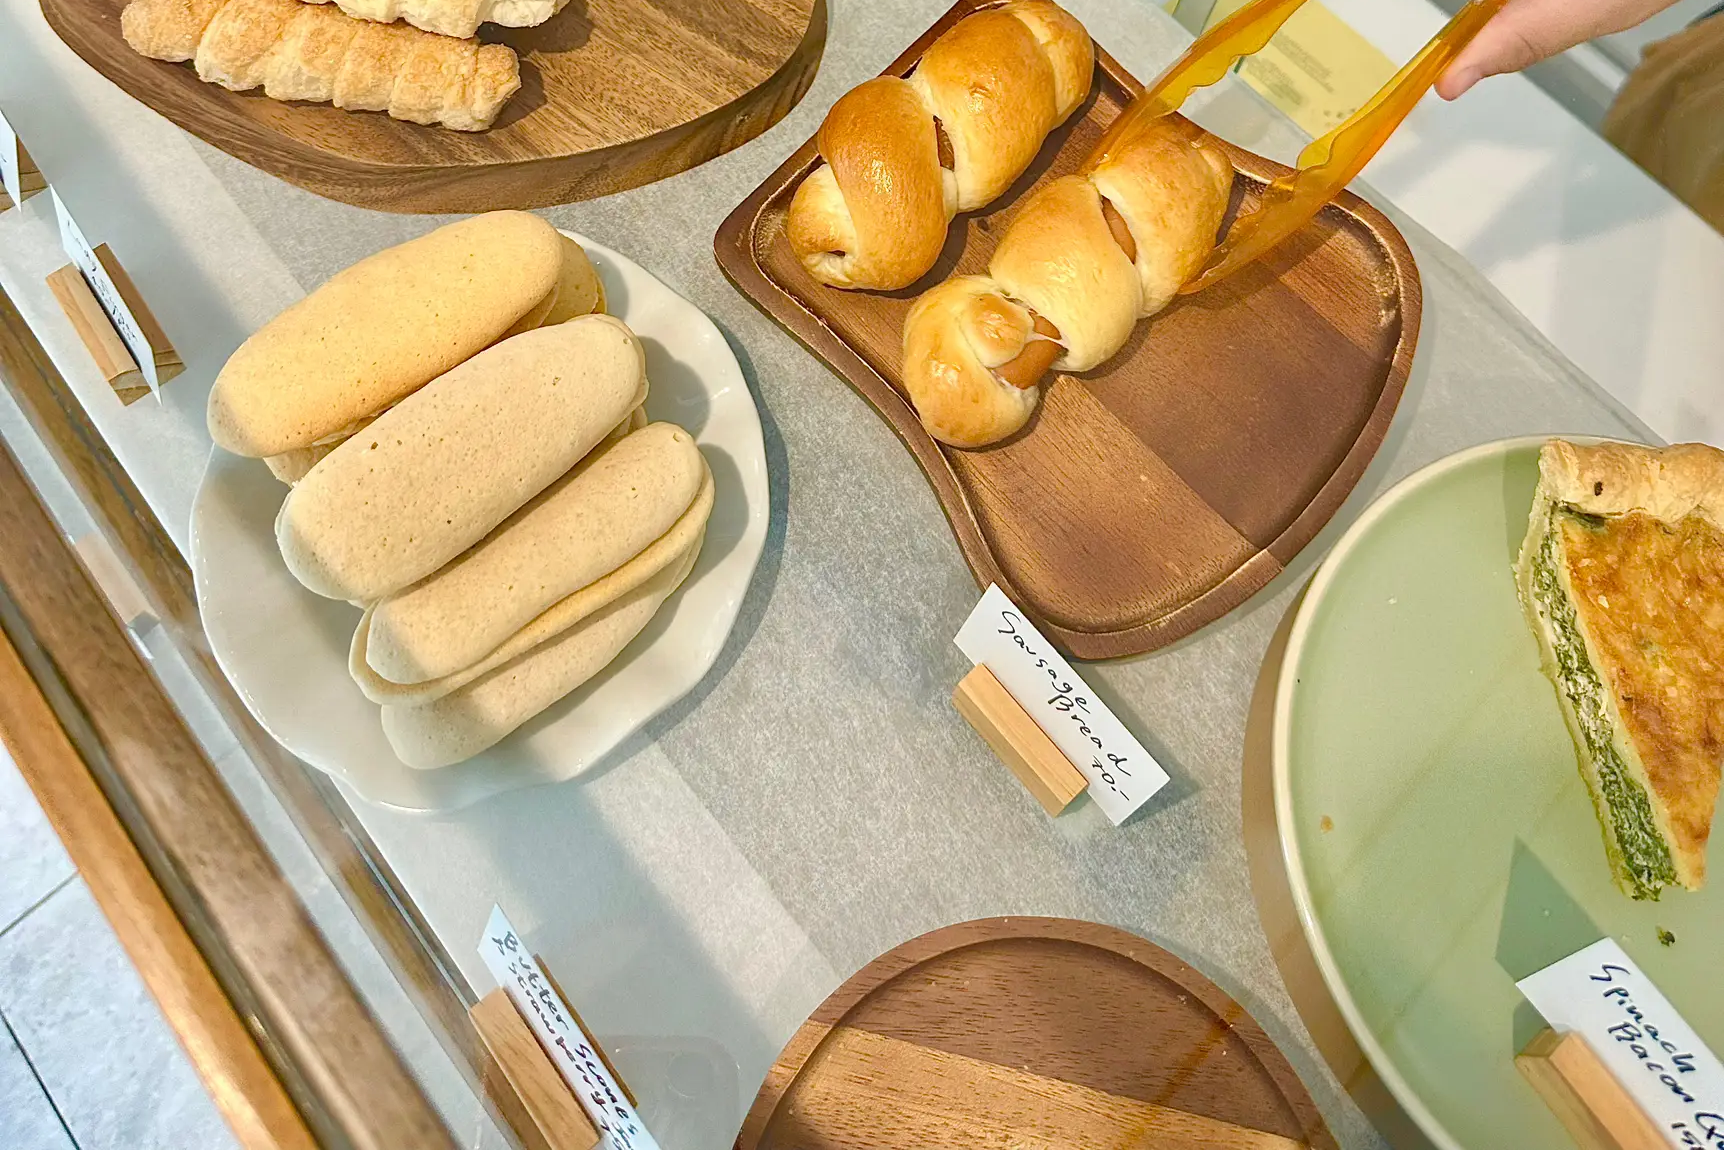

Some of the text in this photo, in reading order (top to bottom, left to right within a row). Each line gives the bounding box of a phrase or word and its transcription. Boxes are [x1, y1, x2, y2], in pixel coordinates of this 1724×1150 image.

[998, 610, 1091, 715] Sausage
[1048, 694, 1132, 777] Bread
[504, 930, 639, 1136] Butter Scones
[1589, 964, 1696, 1074] Spinach
[1607, 1021, 1695, 1102] Bacon
